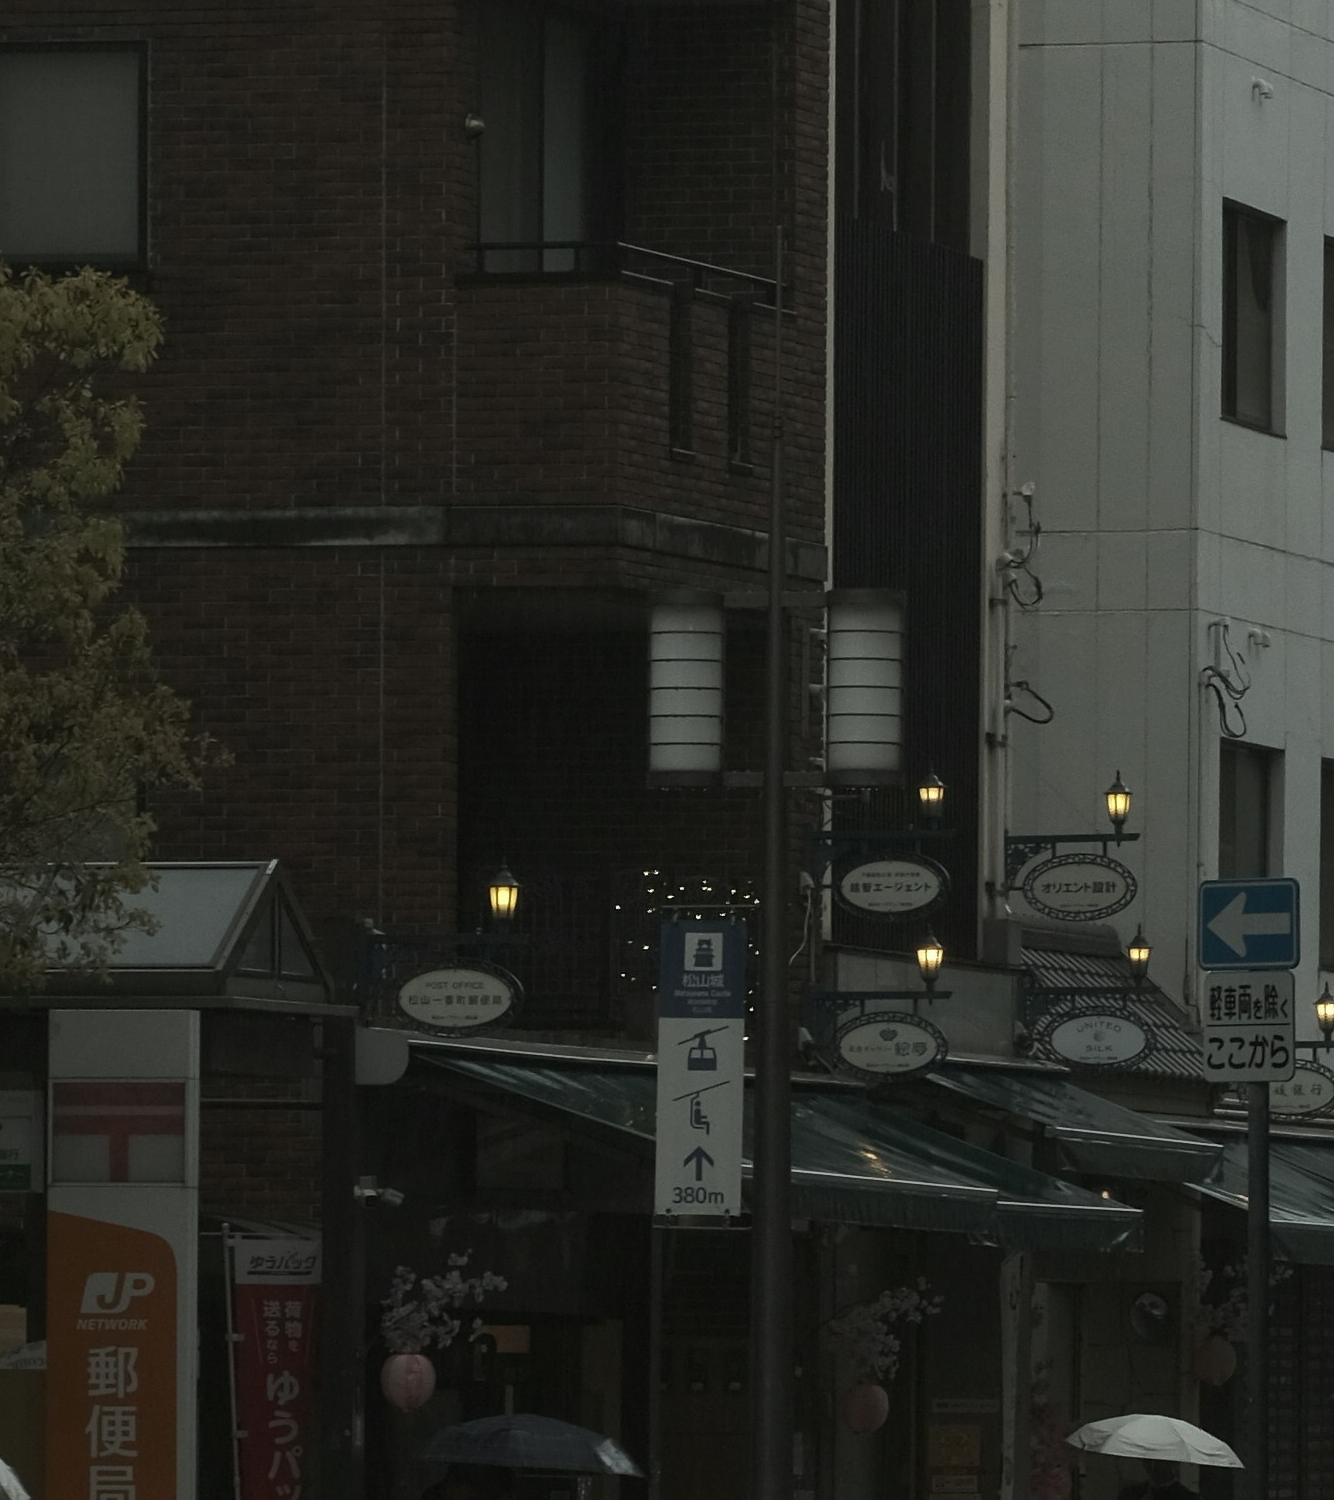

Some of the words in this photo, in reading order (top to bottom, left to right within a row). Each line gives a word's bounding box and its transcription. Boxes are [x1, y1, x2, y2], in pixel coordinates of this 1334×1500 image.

[1041, 881, 1117, 893] オリエント設計
[426, 982, 448, 990] POST
[452, 982, 485, 990] OFFICE
[683, 973, 724, 988] 松山城
[1210, 985, 1288, 1020] 軽車両を除く
[1076, 1021, 1122, 1033] UNITED
[1086, 1045, 1114, 1053] SILK
[1208, 1034, 1289, 1069] ここから
[672, 1187, 725, 1204] 380m
[250, 1248, 317, 1270] ゆうパック
[80, 1272, 156, 1314] JP
[76, 1318, 148, 1331] NETWORK
[263, 1300, 282, 1364] 送るなら
[284, 1300, 303, 1352] 荷物を
